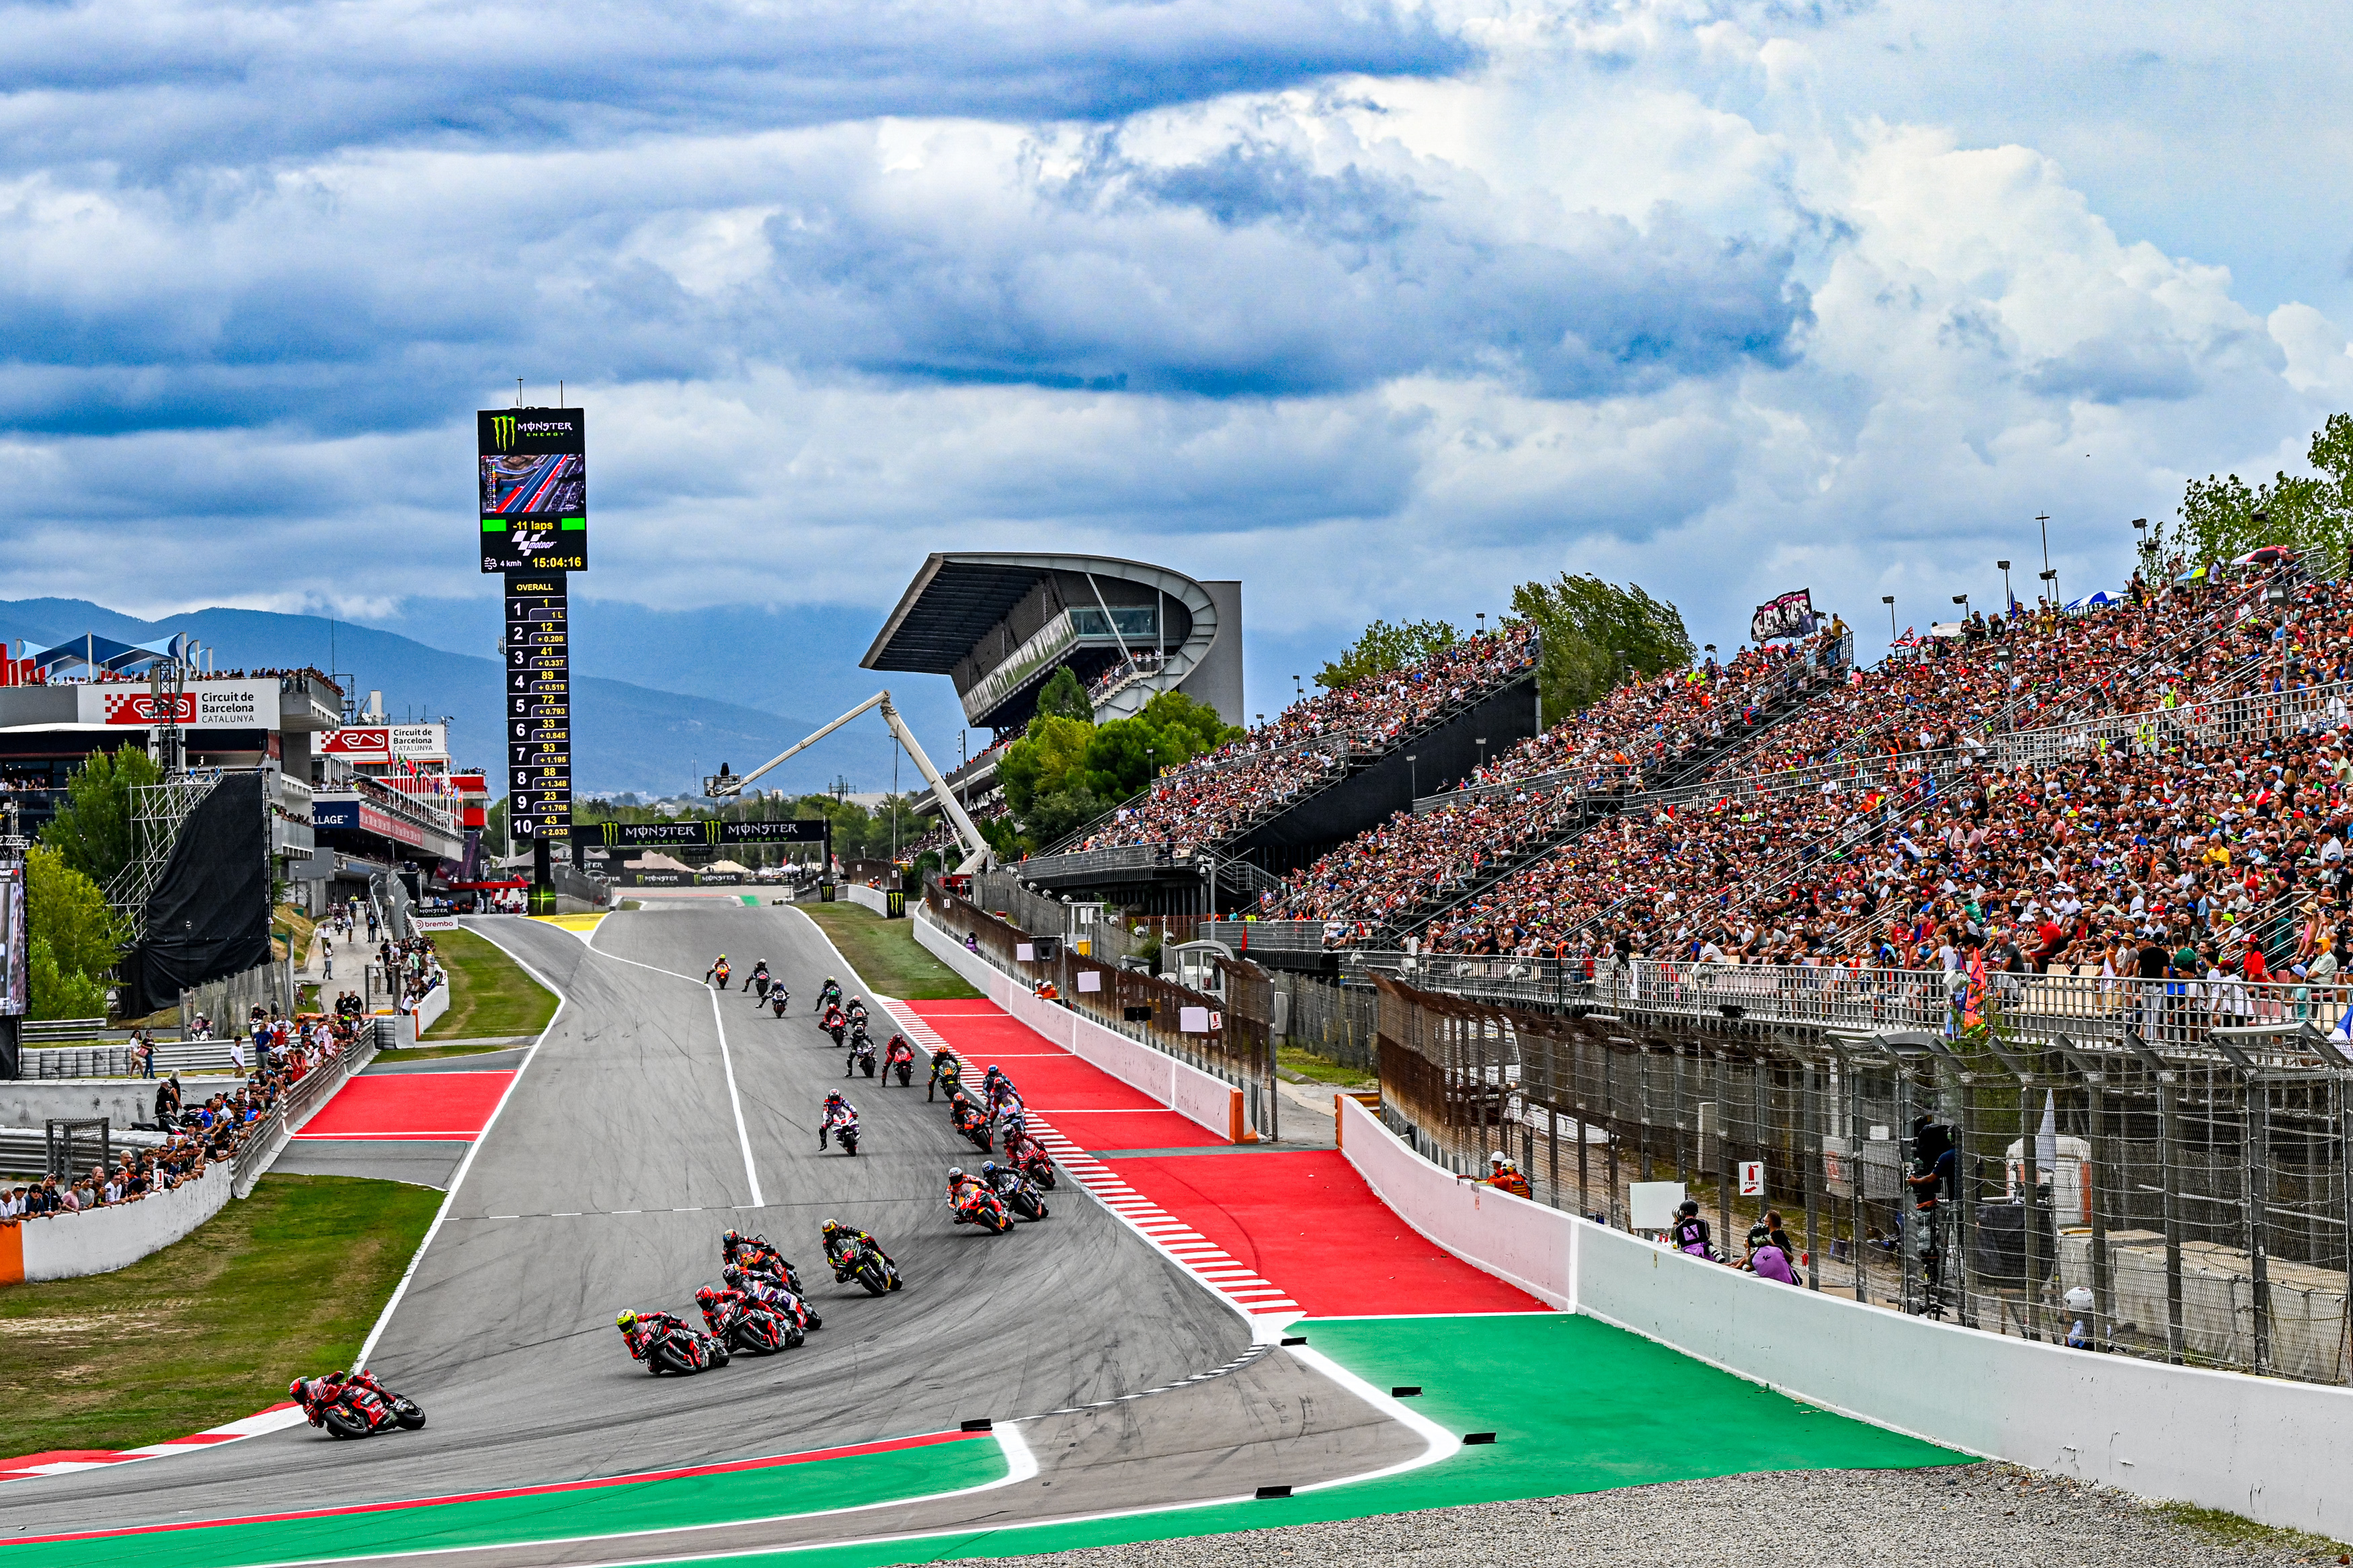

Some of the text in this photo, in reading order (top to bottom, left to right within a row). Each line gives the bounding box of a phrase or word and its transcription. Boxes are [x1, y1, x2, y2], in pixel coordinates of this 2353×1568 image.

[518, 421, 572, 431] MONSTER
[513, 520, 553, 530] -11 laps
[532, 557, 582, 568] 15:04:16
[543, 599, 548, 607] 1
[514, 603, 520, 616] 1
[541, 623, 553, 631] 12
[514, 627, 523, 640] 2
[541, 647, 552, 655] 41
[514, 651, 523, 664] 3
[542, 671, 553, 679] 89
[515, 675, 524, 688] 4
[202, 692, 253, 702] Circuit de
[542, 695, 554, 704] 72
[202, 703, 253, 712] Barcelona
[516, 699, 524, 712] 5
[543, 719, 555, 728] 33
[516, 723, 525, 736] 6
[543, 743, 555, 752] 93
[517, 747, 526, 760] 7
[544, 768, 555, 776] 88
[518, 772, 526, 784] 8
[545, 792, 556, 800] 23
[518, 796, 526, 809] 9
[545, 816, 557, 824] 43
[514, 820, 532, 833] 10
[626, 825, 695, 838] MONSTER
[728, 823, 798, 835] MONSTER
[965, 1193, 975, 1207] 93
